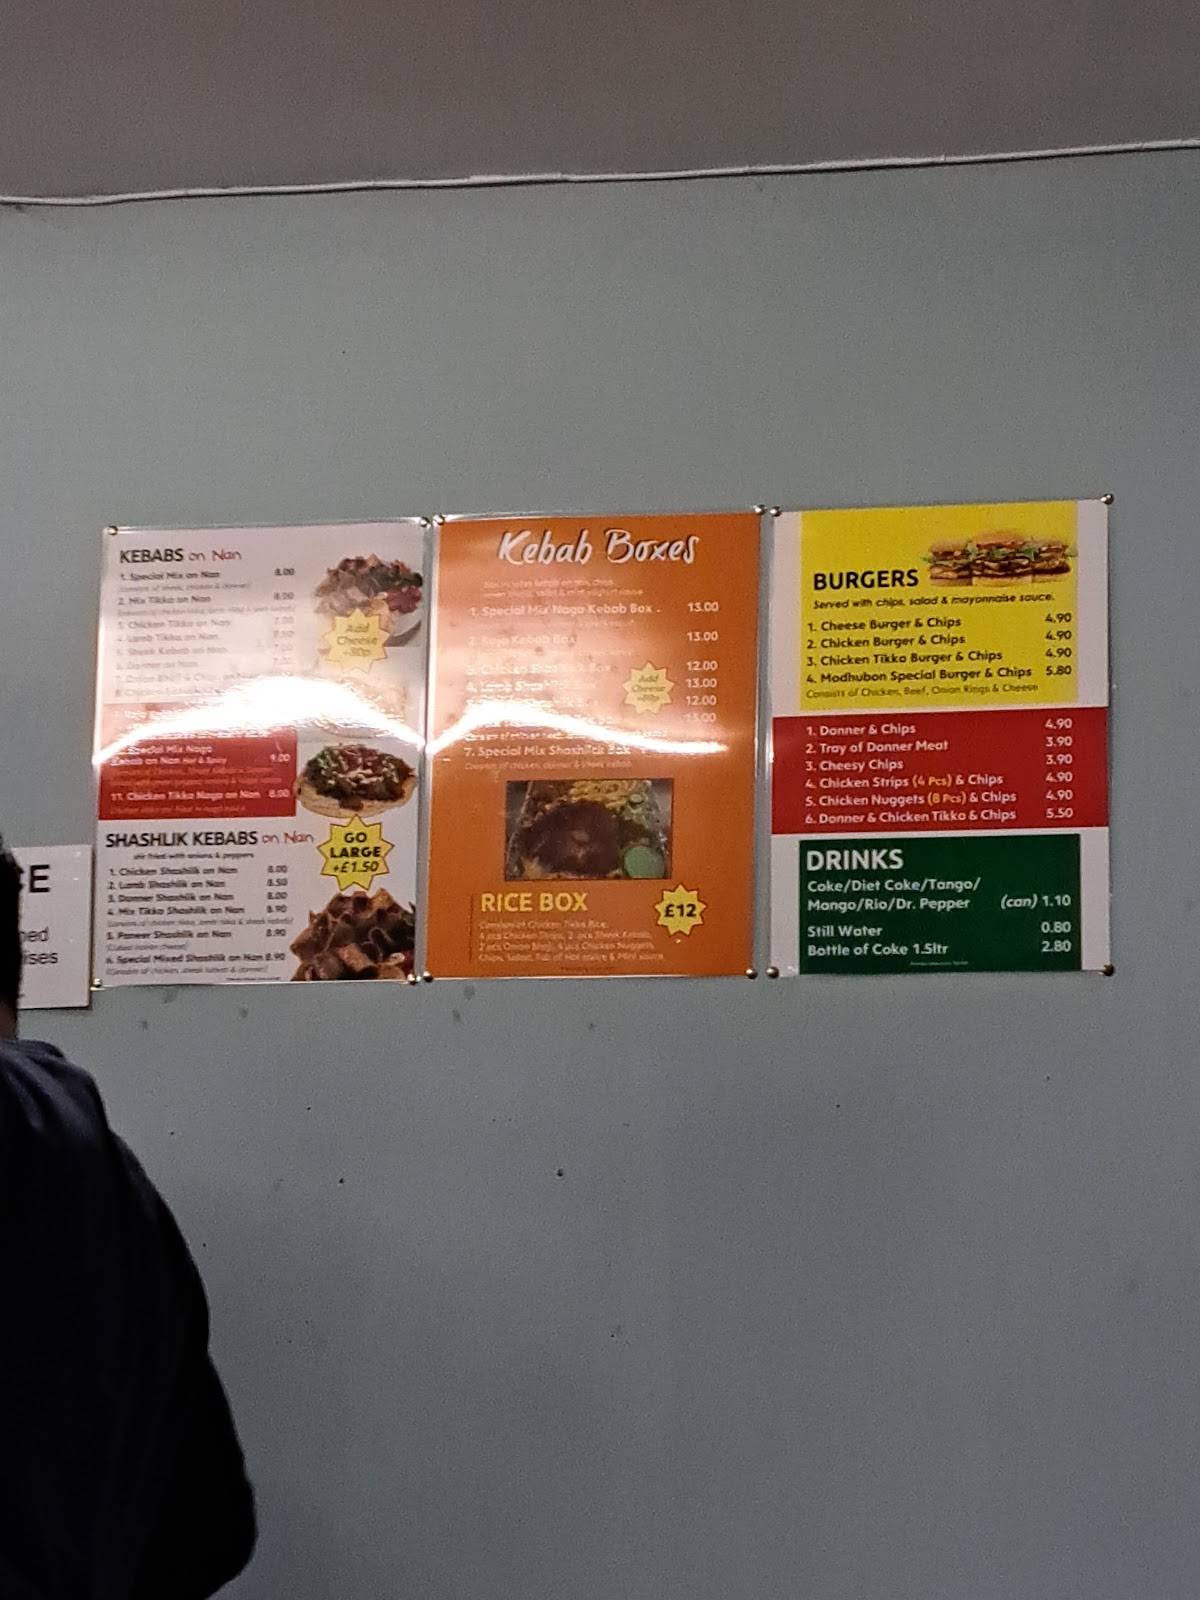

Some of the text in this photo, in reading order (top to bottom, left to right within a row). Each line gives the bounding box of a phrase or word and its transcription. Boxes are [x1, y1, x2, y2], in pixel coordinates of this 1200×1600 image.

[497, 528, 700, 565] Kebab Boxes
[120, 548, 242, 563] KEBABS on Nan
[813, 569, 919, 590] BURGERS
[481, 607, 527, 618] Special
[588, 604, 627, 614] Kebab
[630, 603, 653, 613] Box
[813, 600, 849, 609] Served
[852, 599, 872, 608] with
[941, 596, 948, 604] &
[808, 613, 1072, 632] 1. Cheese Burger & Chips 4.90
[807, 630, 1072, 649] 2. Chicken Burger & Chips 4.90
[807, 657, 817, 666] 3.
[821, 654, 870, 666] Chicken
[911, 652, 952, 665] Burger
[955, 652, 963, 661] &
[968, 650, 1003, 662] Chips
[1045, 647, 1072, 658] 4.90
[687, 661, 718, 671] 12.00
[806, 674, 817, 683] 4.
[891, 670, 935, 682] Special
[940, 669, 981, 681] Burger
[985, 669, 992, 677] &
[997, 667, 1032, 678] Chips
[1045, 665, 1072, 676] 5.80
[848, 688, 859, 697] of
[992, 684, 999, 692] &
[686, 695, 717, 705] 12.00
[807, 726, 816, 736] 1.
[869, 725, 877, 734] &
[880, 723, 917, 736] Chips
[1045, 718, 1073, 729] 4.90
[465, 748, 475, 756] 7.
[479, 746, 521, 758] Special
[524, 747, 545, 755] Mix
[805, 744, 816, 754] 2.
[820, 743, 847, 756] Tray
[850, 742, 864, 753] of
[916, 741, 949, 751] Meat
[1045, 736, 1073, 747] 3.90
[805, 754, 1073, 773] 3. Cheesy Chips 3.90
[805, 772, 1073, 790] 4. Chicken Strips (4 Pcs) & Chips 4.90
[805, 797, 816, 806] 5.
[819, 795, 868, 807] Chicken
[871, 794, 925, 807] Nuggets
[942, 792, 967, 805] Pcs)
[970, 793, 978, 802] &
[981, 791, 1017, 803] Chips
[1045, 790, 1073, 800] 4.90
[805, 815, 816, 824] 6.
[867, 813, 876, 822] &
[879, 811, 929, 822] Chicken
[969, 810, 977, 820] &
[980, 809, 1016, 821] Chips
[1046, 807, 1073, 818] 5.50
[106, 831, 314, 847] SHASHLIK KEBABS on Nan
[344, 832, 367, 843] GO
[331, 847, 381, 858] LARGE
[806, 849, 904, 871] DRINKS
[808, 879, 881, 893] Coke/Diet
[480, 892, 588, 912] RICE BOX
[664, 903, 697, 917] £12
[920, 898, 971, 912] Pepper
[1000, 894, 1038, 910] (can)
[1042, 895, 1071, 907] 1.10
[808, 921, 1071, 937] Still Water 0.80
[808, 944, 850, 956] Bottle
[854, 943, 869, 955] of
[872, 943, 908, 955] Coke
[1041, 940, 1072, 952] 2.80
